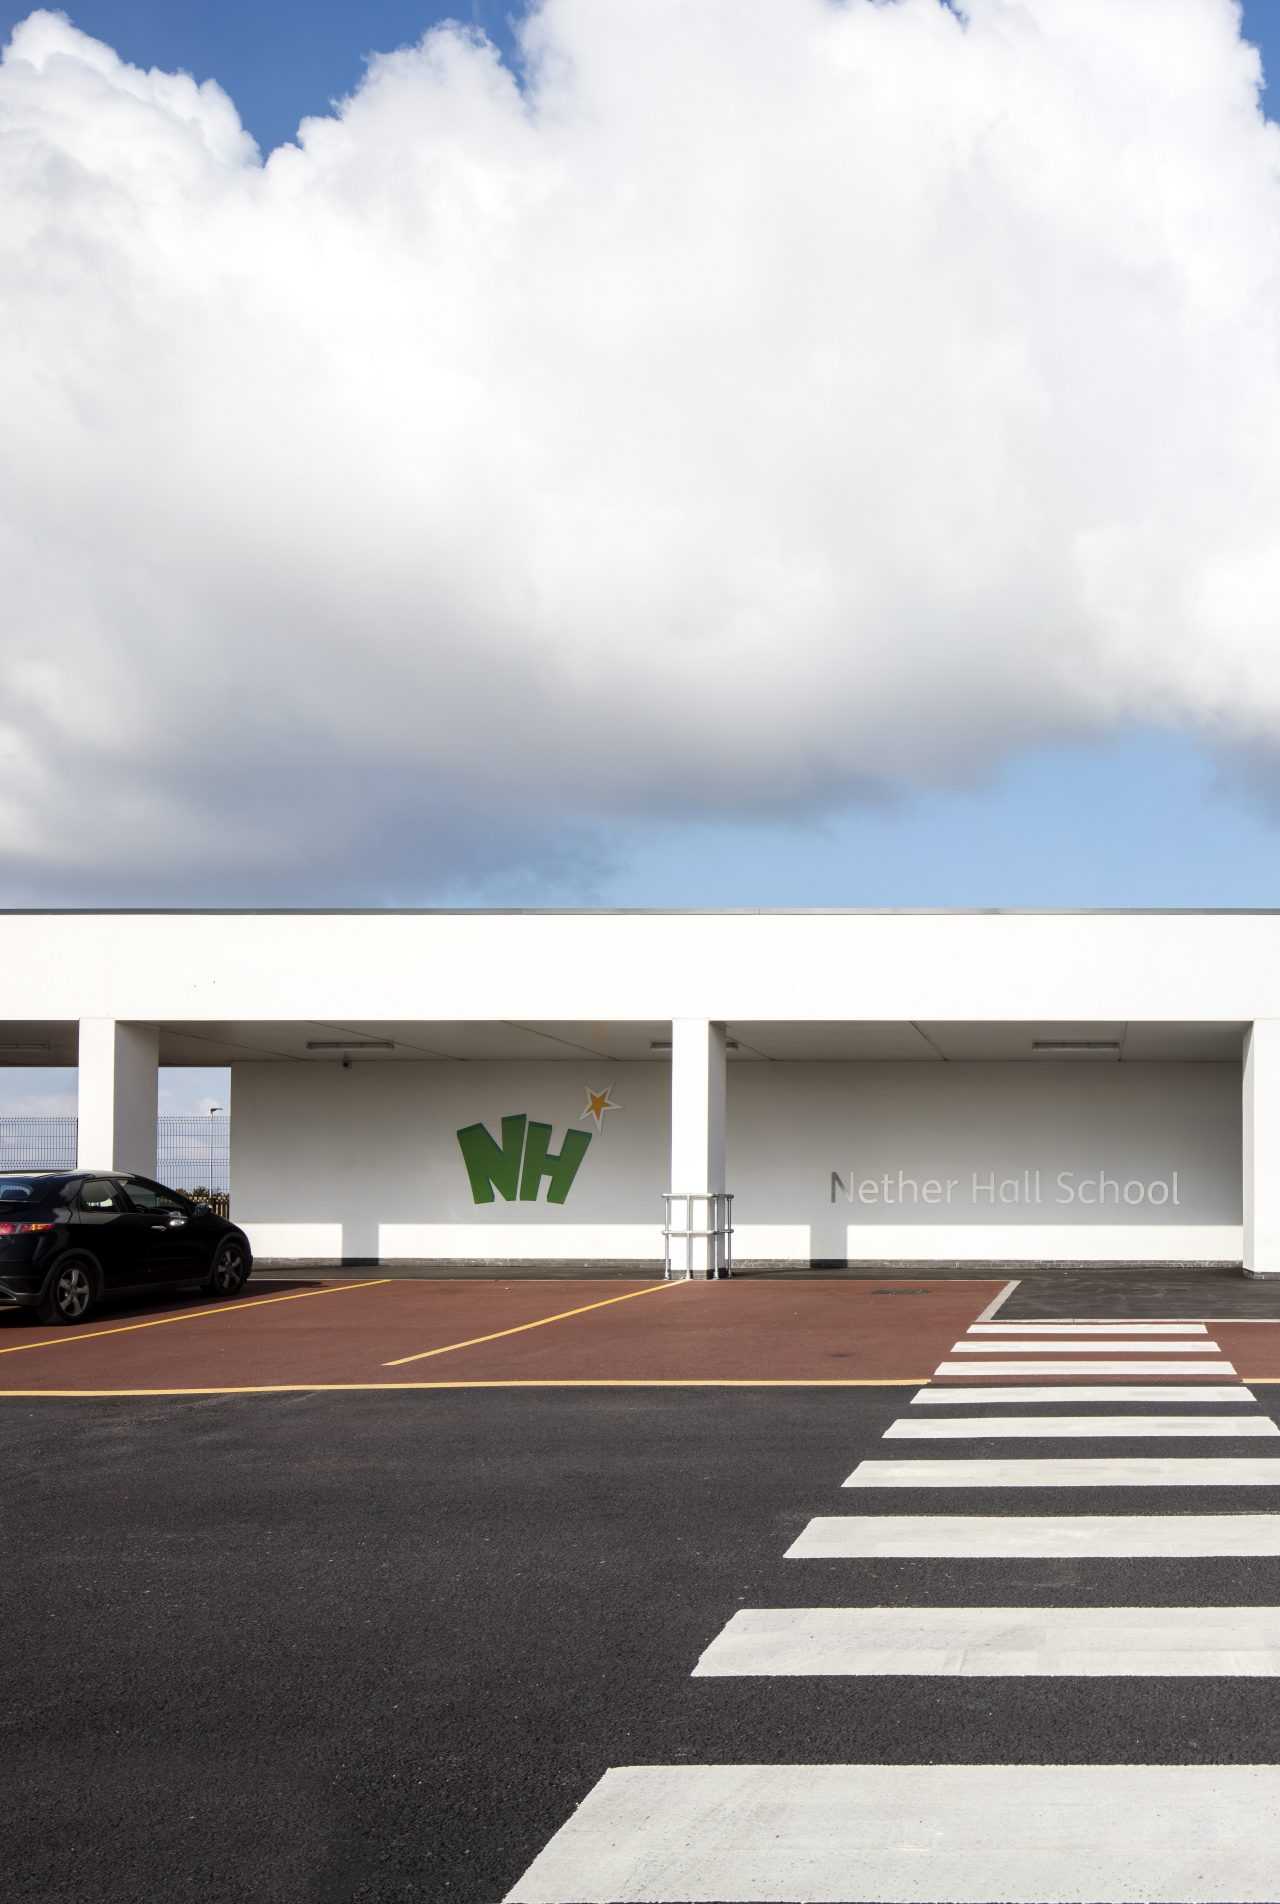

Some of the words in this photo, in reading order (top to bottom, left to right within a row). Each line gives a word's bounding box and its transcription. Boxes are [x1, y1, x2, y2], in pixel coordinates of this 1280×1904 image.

[456, 1113, 592, 1205] NH
[831, 1170, 959, 1205] Nether
[972, 1170, 1041, 1205] Hall
[1056, 1170, 1181, 1205] School
